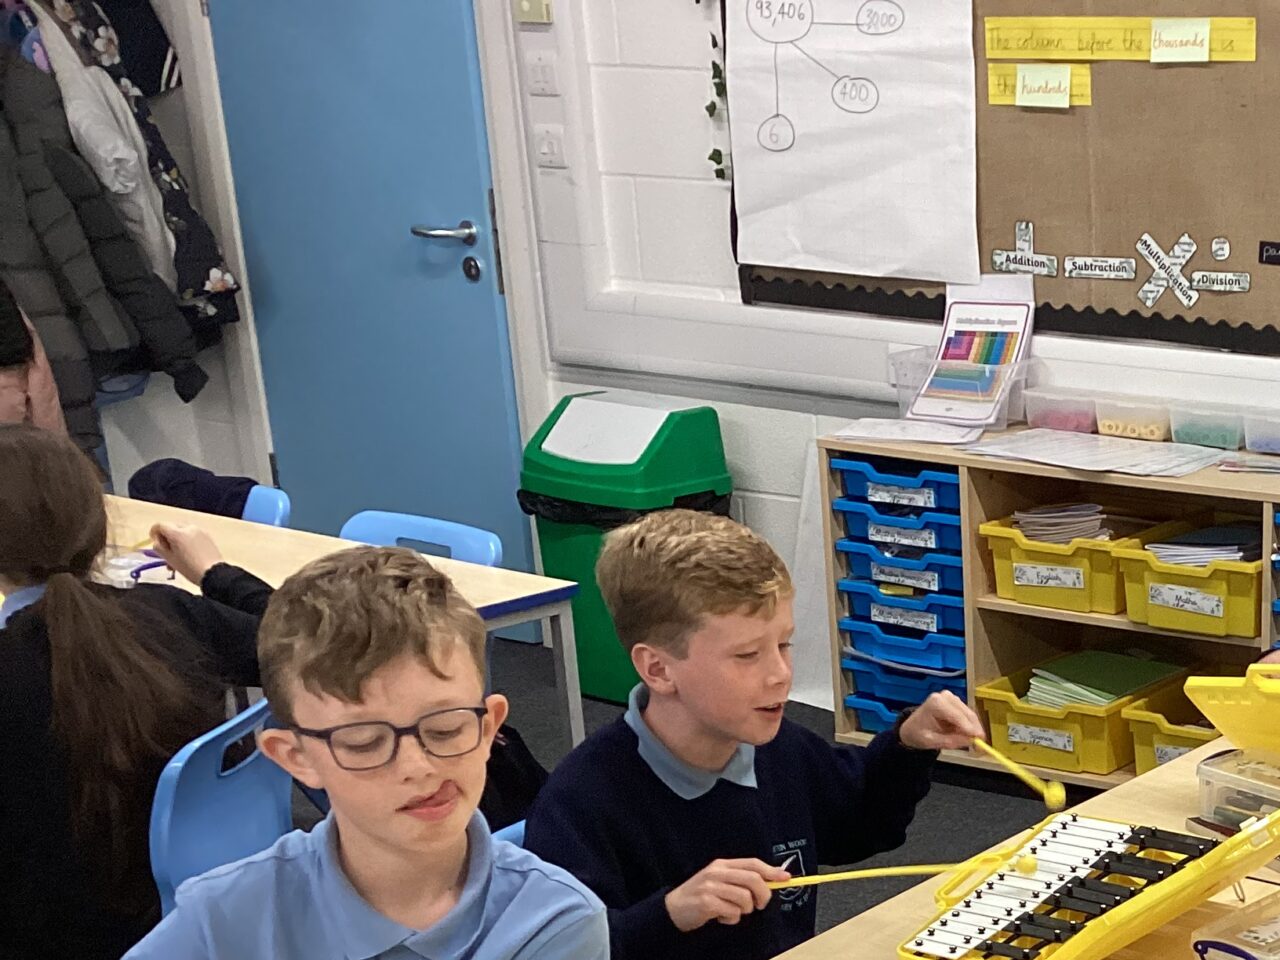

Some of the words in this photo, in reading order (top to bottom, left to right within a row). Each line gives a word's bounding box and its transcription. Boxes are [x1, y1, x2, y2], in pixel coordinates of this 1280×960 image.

[1078, 31, 1113, 55] before
[1122, 30, 1144, 50] the
[1153, 31, 1206, 49] thousands
[769, 124, 779, 143] 6
[1005, 254, 1045, 268] Addition
[1072, 262, 1127, 273] Subtraction
[1141, 239, 1193, 302] Multiplication
[1201, 274, 1241, 286] Division
